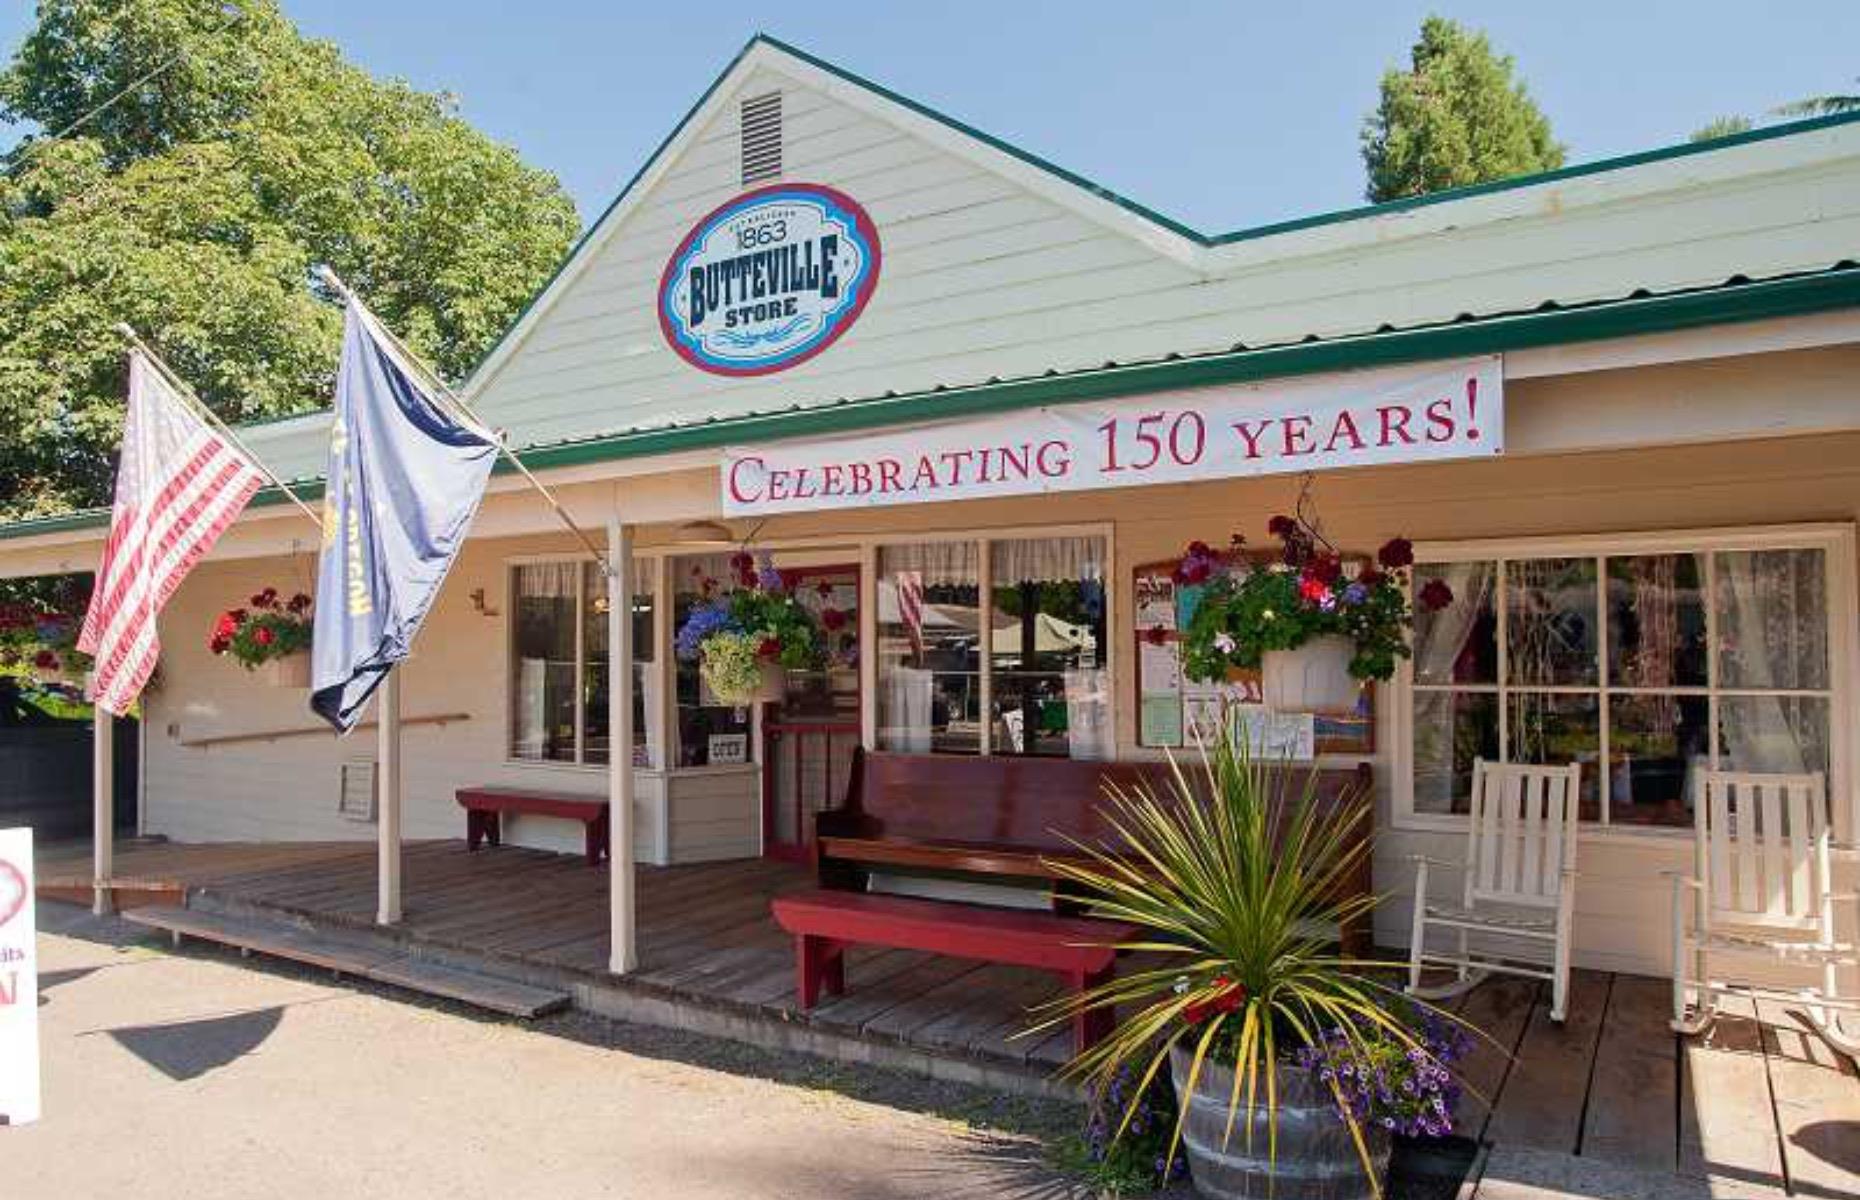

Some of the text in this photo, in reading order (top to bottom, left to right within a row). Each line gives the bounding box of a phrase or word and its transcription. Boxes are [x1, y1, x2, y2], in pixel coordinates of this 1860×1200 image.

[735, 221, 787, 250] 1863
[689, 234, 839, 328] BUTTEVILLE
[724, 297, 799, 329] STORE
[1097, 410, 1206, 472] 150
[1231, 377, 1481, 459] YEARS!
